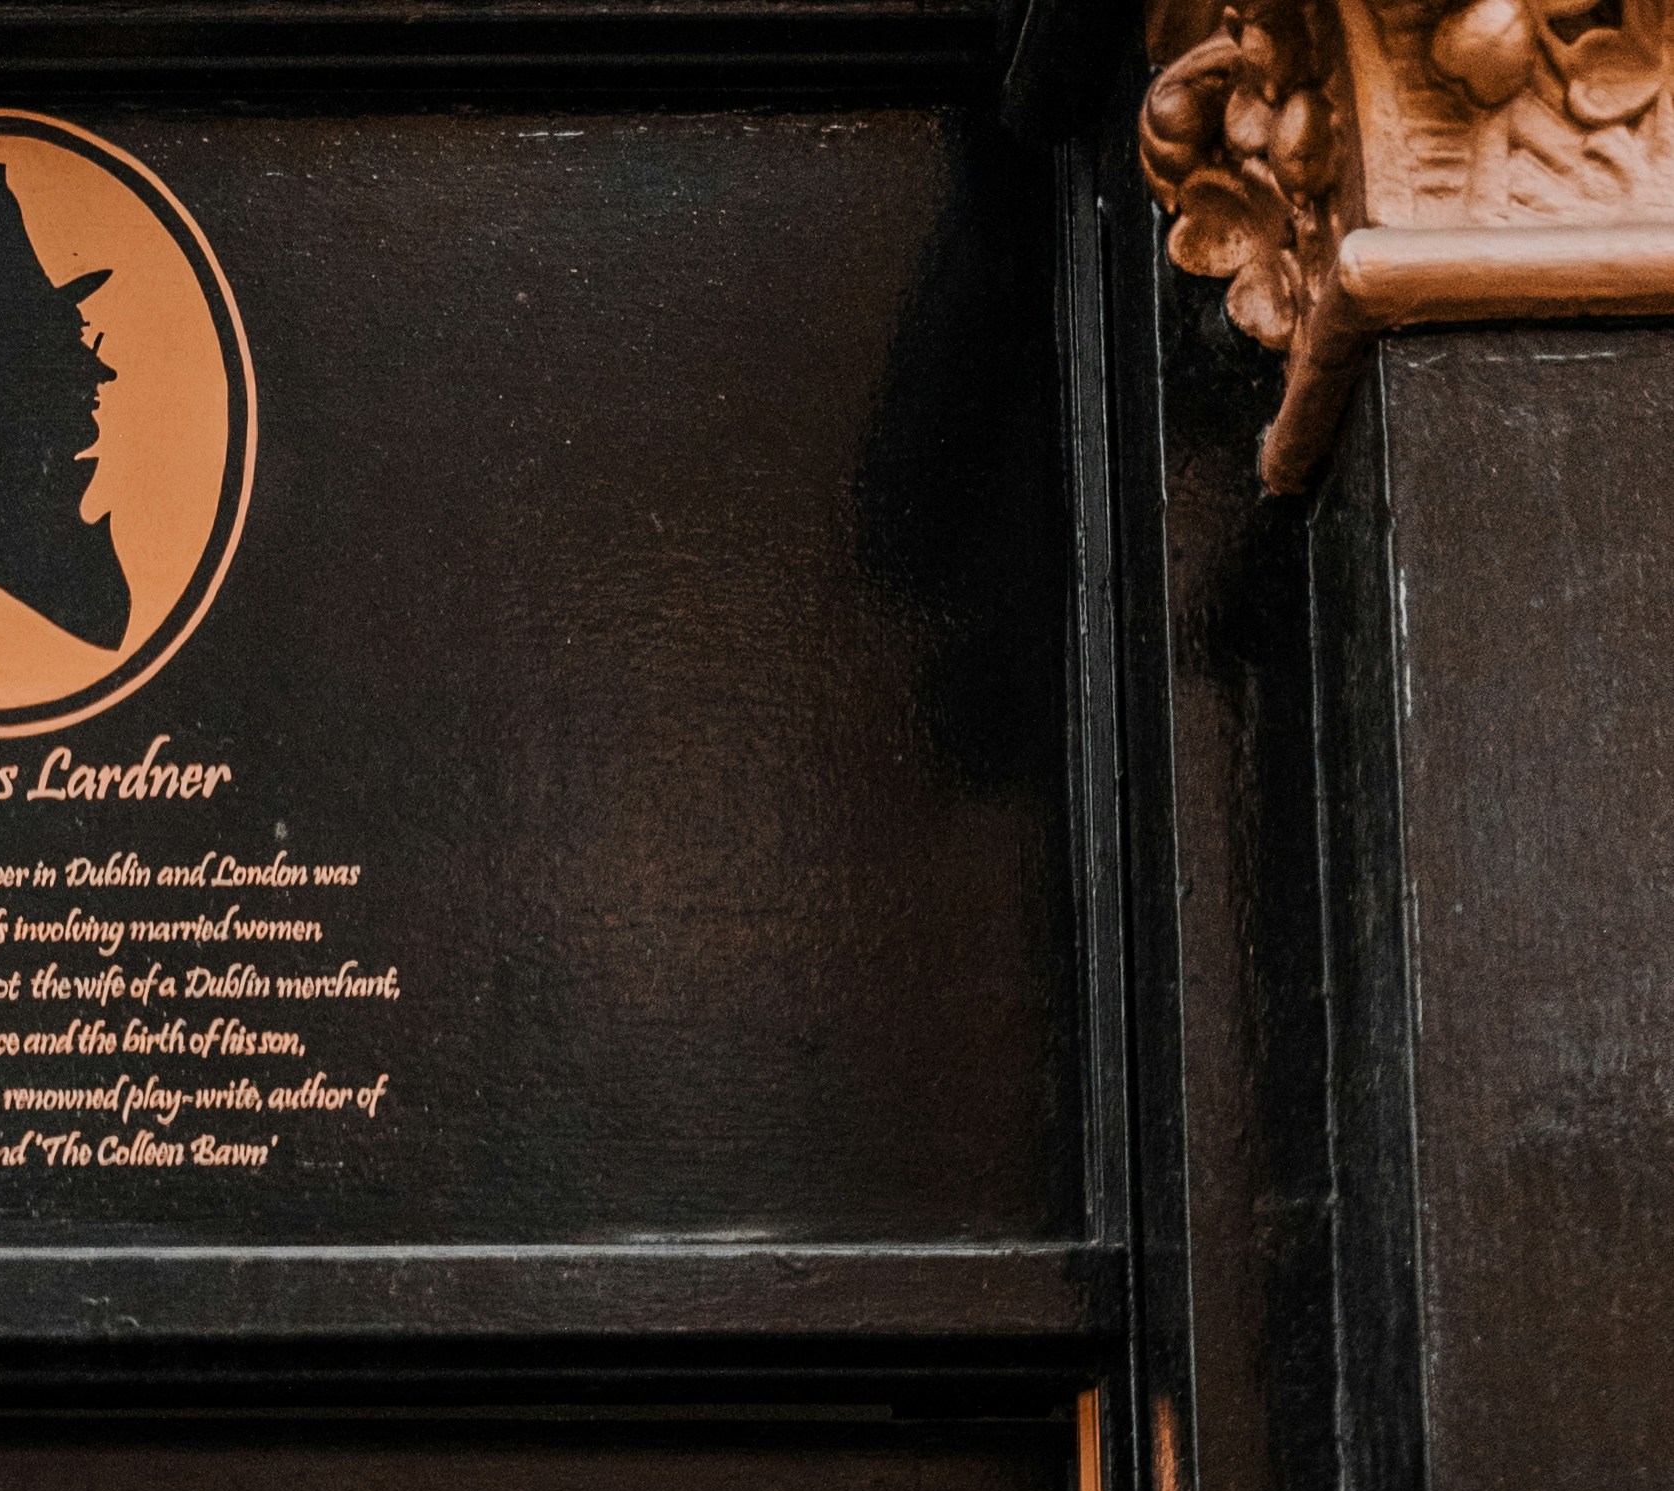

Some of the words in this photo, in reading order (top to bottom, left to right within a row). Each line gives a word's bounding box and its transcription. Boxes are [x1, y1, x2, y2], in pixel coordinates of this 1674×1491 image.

[27, 735, 231, 801] Lardner
[33, 861, 56, 887] in
[65, 852, 150, 887] Dublin
[157, 851, 209, 887] and
[211, 850, 308, 886] London
[314, 865, 360, 885] was
[14, 908, 124, 956] involving
[130, 905, 236, 942] married
[31, 963, 71, 999] the
[74, 965, 125, 1006] wife
[130, 963, 161, 1005] of
[159, 977, 176, 997] a
[185, 963, 270, 998] Dublin
[276, 960, 400, 1000] merchant,
[23, 1019, 78, 1054] and
[78, 1020, 117, 1054] the
[122, 1018, 186, 1054] birth
[190, 1018, 224, 1058] of
[221, 1018, 257, 1055] his
[4, 1075, 127, 1111] renowned
[122, 1075, 262, 1125] play-write,
[268, 1072, 353, 1111] author
[357, 1074, 388, 1117] of
[97, 1130, 184, 1166] Colleen
